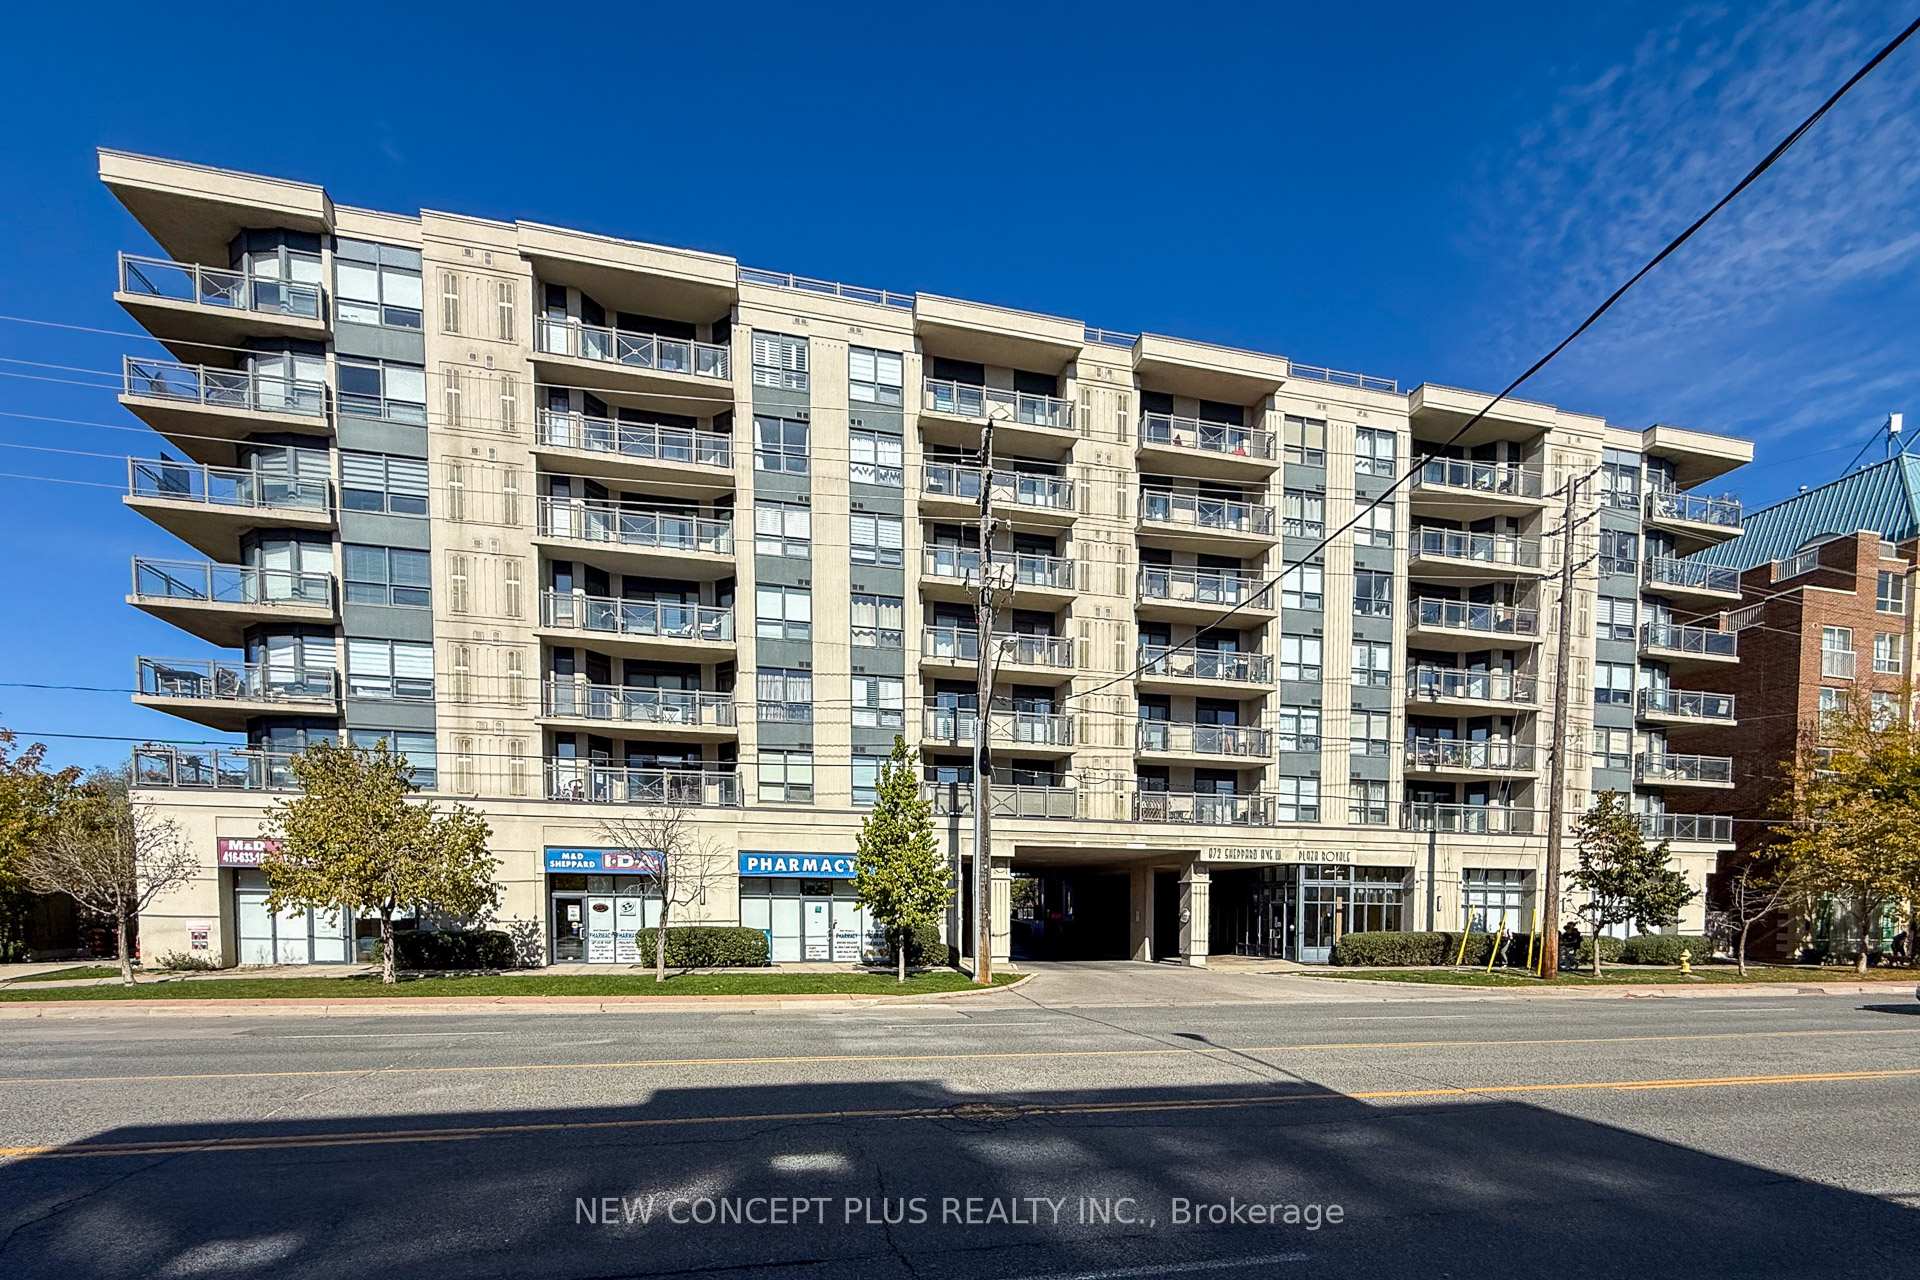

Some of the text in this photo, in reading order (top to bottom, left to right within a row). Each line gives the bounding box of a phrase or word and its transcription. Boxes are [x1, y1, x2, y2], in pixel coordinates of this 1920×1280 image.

[228, 840, 266, 851] M&D
[561, 852, 584, 860] M&D
[1224, 848, 1257, 860] SHEPPARD
[1260, 849, 1273, 860] AVE
[1298, 850, 1351, 863] PLAZA ROYALE
[549, 860, 596, 868] SHEPPARD
[747, 857, 856, 873] PHARMACY
